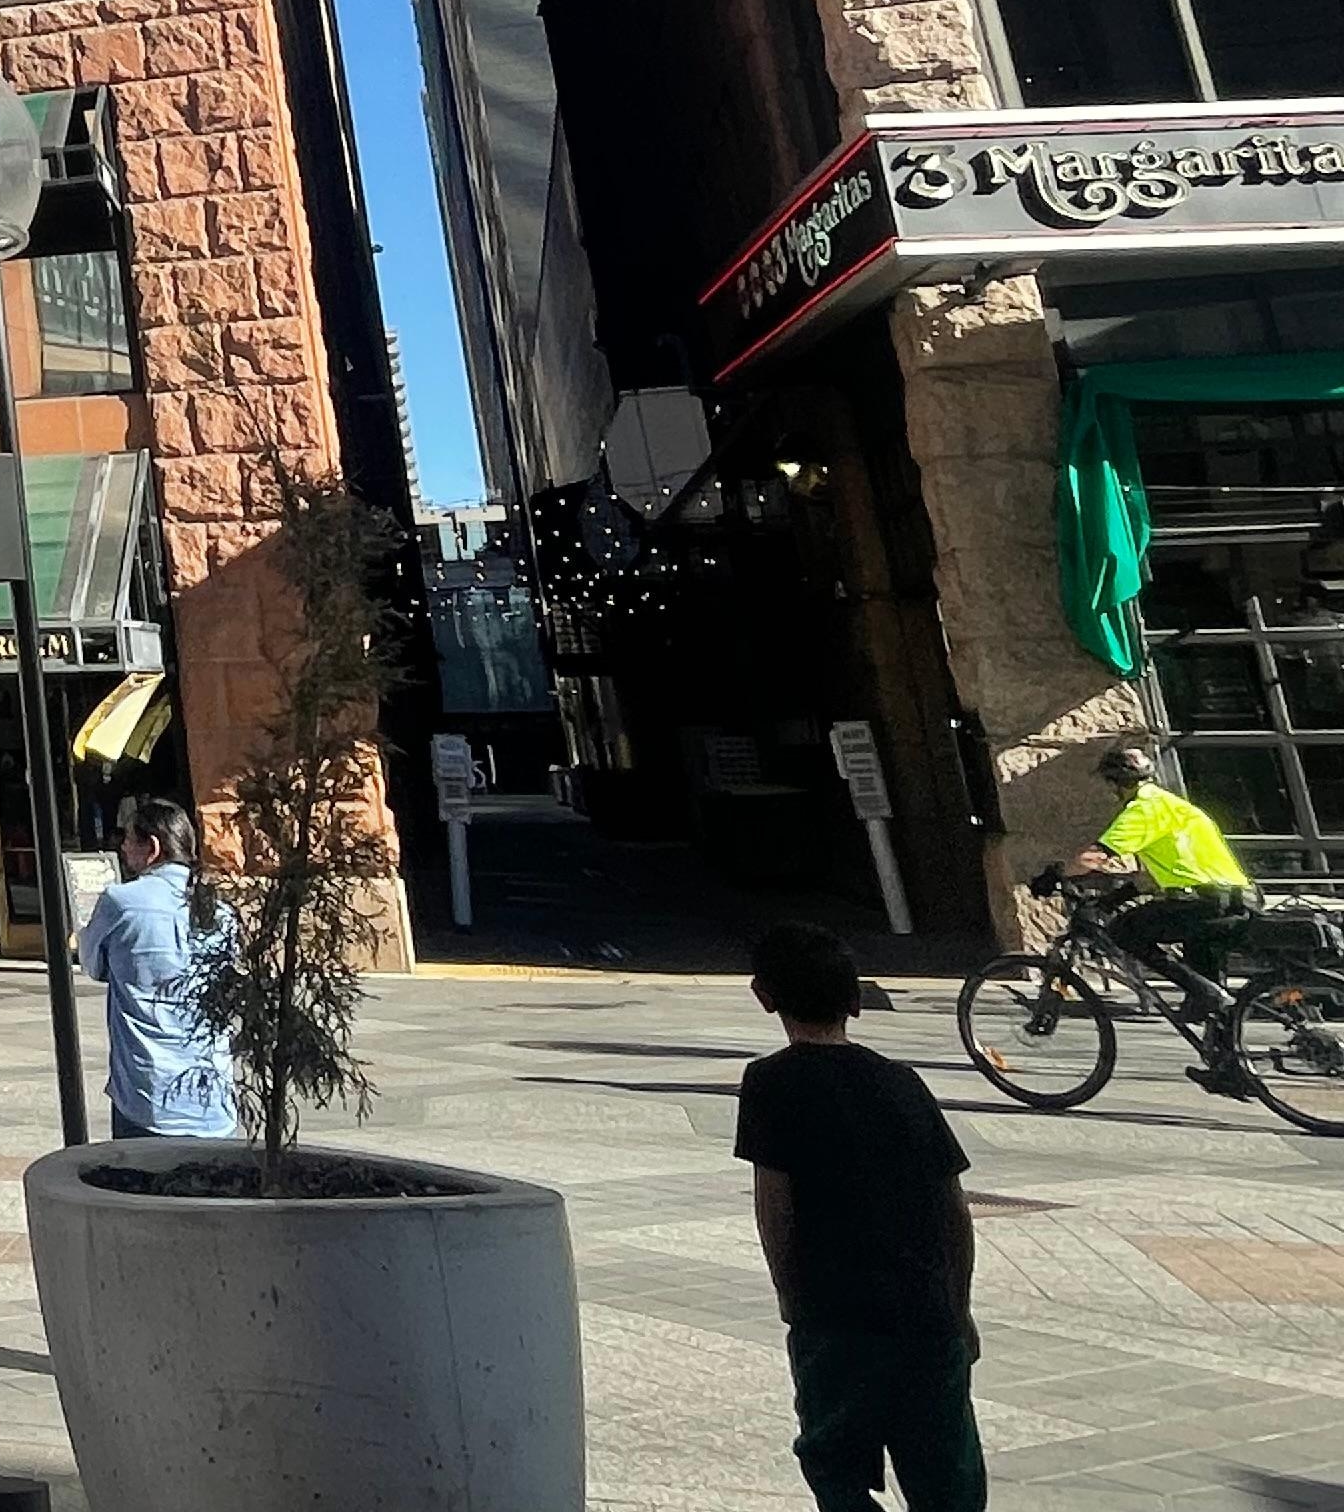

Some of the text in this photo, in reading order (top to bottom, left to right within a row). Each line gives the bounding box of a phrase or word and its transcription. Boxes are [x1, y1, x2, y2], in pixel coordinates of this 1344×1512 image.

[891, 144, 967, 208] 3
[771, 170, 872, 286] 3 Margaritas
